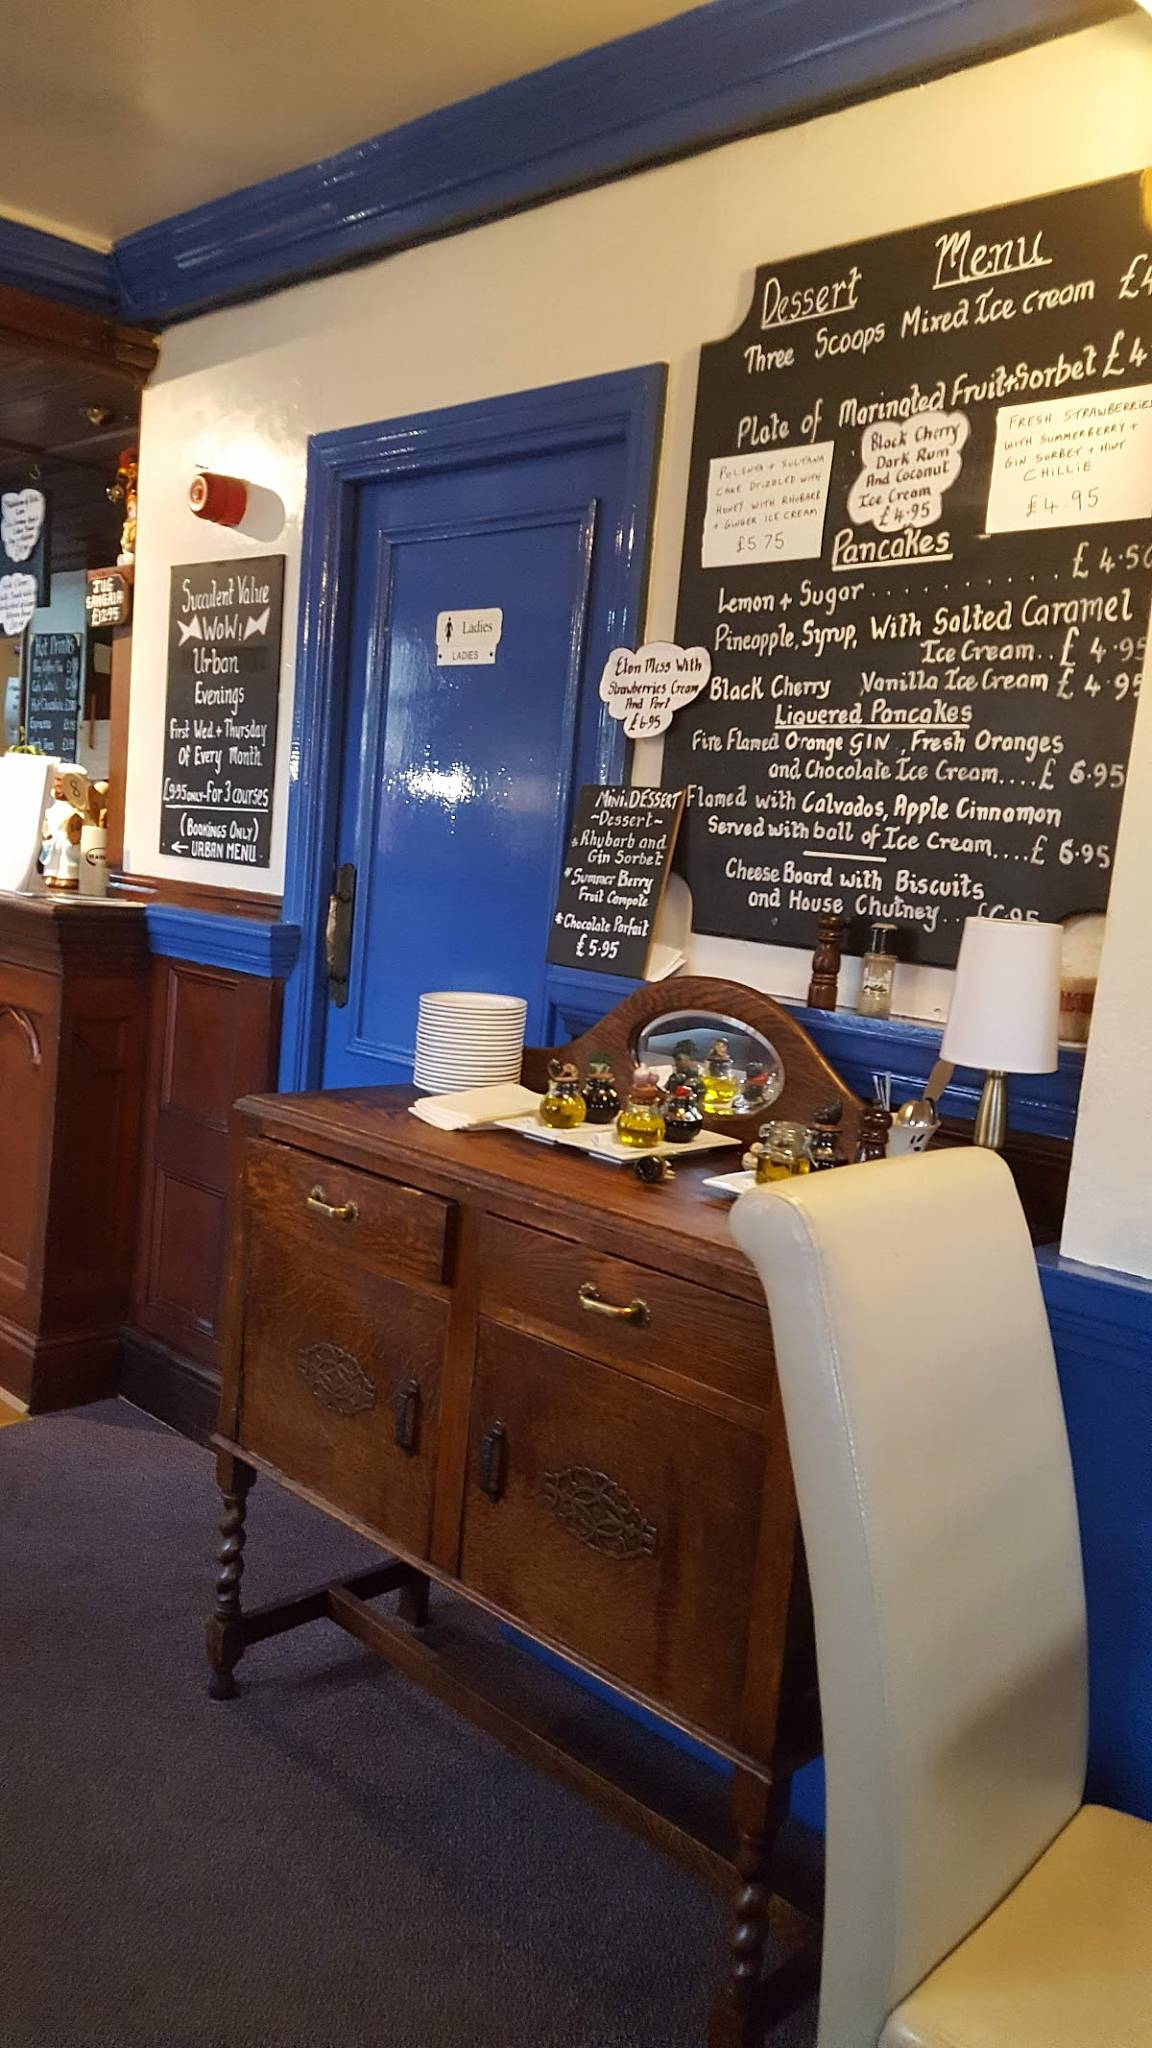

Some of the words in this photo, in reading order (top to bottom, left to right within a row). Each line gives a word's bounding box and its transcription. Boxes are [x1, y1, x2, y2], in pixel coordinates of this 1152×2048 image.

[762, 267, 862, 326] Dessert
[934, 230, 1047, 285] Menu
[744, 344, 795, 374] Three
[815, 322, 885, 359] Scoops
[901, 298, 969, 338] Mixed
[974, 287, 1016, 324] Ice
[738, 412, 790, 448] Plate
[801, 398, 823, 443] of
[839, 381, 946, 427] Marinated
[1009, 413, 1052, 430] FRESH
[1064, 399, 1152, 421] STRAWBERRIE
[871, 431, 907, 452] Black
[915, 423, 961, 446] Cherry
[1004, 437, 1032, 450] WITH
[1040, 422, 1125, 445] SUMMERBERRY
[876, 452, 910, 470] Dark
[916, 448, 949, 462] Rum
[1004, 456, 1026, 469] GIN
[800, 472, 821, 483] WITH
[866, 473, 890, 488] And
[895, 461, 950, 483] Coconut
[751, 499, 775, 509] WITH
[858, 495, 882, 508] Ice
[888, 486, 932, 504] Cream
[764, 512, 780, 522] ICE
[783, 508, 818, 519] CREAM
[832, 527, 950, 566] Pancakes
[237, 575, 270, 604] Value
[717, 587, 774, 614] Lemon
[799, 579, 865, 616] Sugar
[462, 620, 493, 634] Ladies
[714, 622, 799, 656] Pineapple,
[870, 612, 922, 640] With
[932, 600, 1012, 635] Salted
[1021, 588, 1133, 627] Caramel
[193, 647, 239, 674] Urban
[452, 650, 479, 661] LADIES
[920, 639, 956, 664] Ice
[615, 656, 641, 676] Eton
[675, 657, 702, 672] With
[608, 680, 666, 695] Strawberries
[671, 679, 699, 695] Cream
[709, 675, 764, 701] Black
[771, 674, 831, 699] Cherry
[861, 669, 938, 693] Vanilla
[943, 666, 978, 691] Ice
[982, 668, 1049, 691] Cream
[195, 681, 245, 716] Evenings
[625, 697, 643, 710] And
[871, 698, 973, 725] Pancakes
[169, 717, 190, 739] First
[224, 717, 267, 747] Thursday
[692, 729, 722, 751] Fire
[727, 727, 779, 751] Flamed
[785, 731, 843, 760] Orange
[911, 729, 966, 752] Fresh
[975, 729, 1064, 763] Oranges
[178, 744, 191, 767] Of
[194, 746, 223, 774] Every
[768, 757, 801, 779] and
[805, 758, 892, 780] Chocolate
[894, 757, 928, 781] Ice
[223, 780, 231, 802] 3
[232, 788, 269, 807] courses
[686, 784, 747, 808] Flamed
[755, 790, 796, 810] with
[801, 790, 889, 821] Calvados,
[893, 794, 949, 824] Apple
[956, 797, 1062, 827] Cinnamon
[639, 834, 667, 849] and
[707, 815, 764, 838] Served
[768, 821, 809, 839] with
[813, 820, 853, 841] ball
[861, 824, 881, 850] of
[882, 826, 920, 851] Ice
[191, 840, 224, 858] URBAN
[226, 843, 256, 862] MENU
[587, 849, 610, 864] Gin
[614, 849, 664, 866] Sorbet
[571, 868, 616, 885] Summer
[617, 869, 653, 894] Berry
[725, 857, 780, 883] Cheese
[783, 860, 833, 887] Board
[839, 870, 882, 891] with
[895, 869, 984, 900] Biscuits
[578, 886, 604, 903] Fruit
[607, 890, 649, 910] Compote
[748, 887, 781, 909] and
[789, 889, 843, 914] House
[563, 913, 611, 932] Chocolate
[613, 915, 649, 937] Parfait
